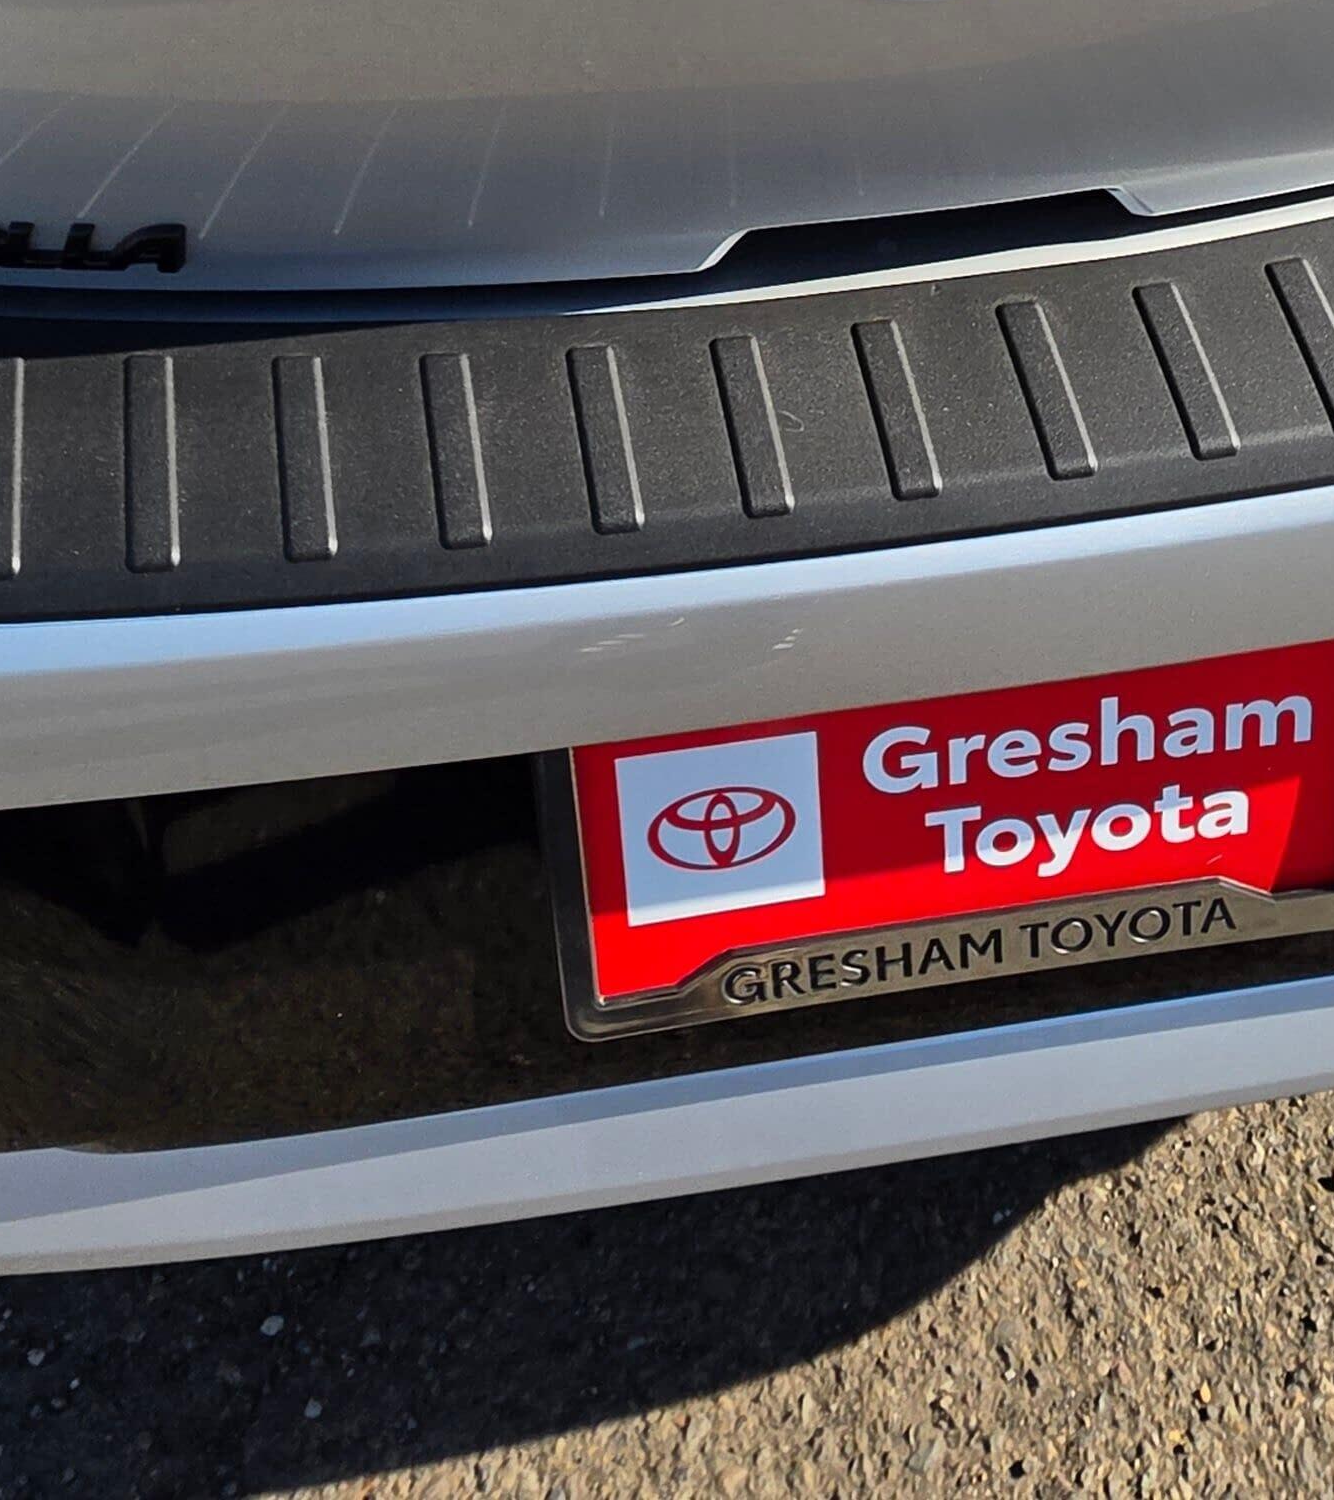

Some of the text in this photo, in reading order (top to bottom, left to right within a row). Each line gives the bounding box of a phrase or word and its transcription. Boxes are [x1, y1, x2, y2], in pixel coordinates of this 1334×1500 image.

[862, 695, 1313, 794] Gresham
[924, 784, 1250, 878] Toyota
[721, 897, 1238, 1005] GRESHAM TOYOTA
